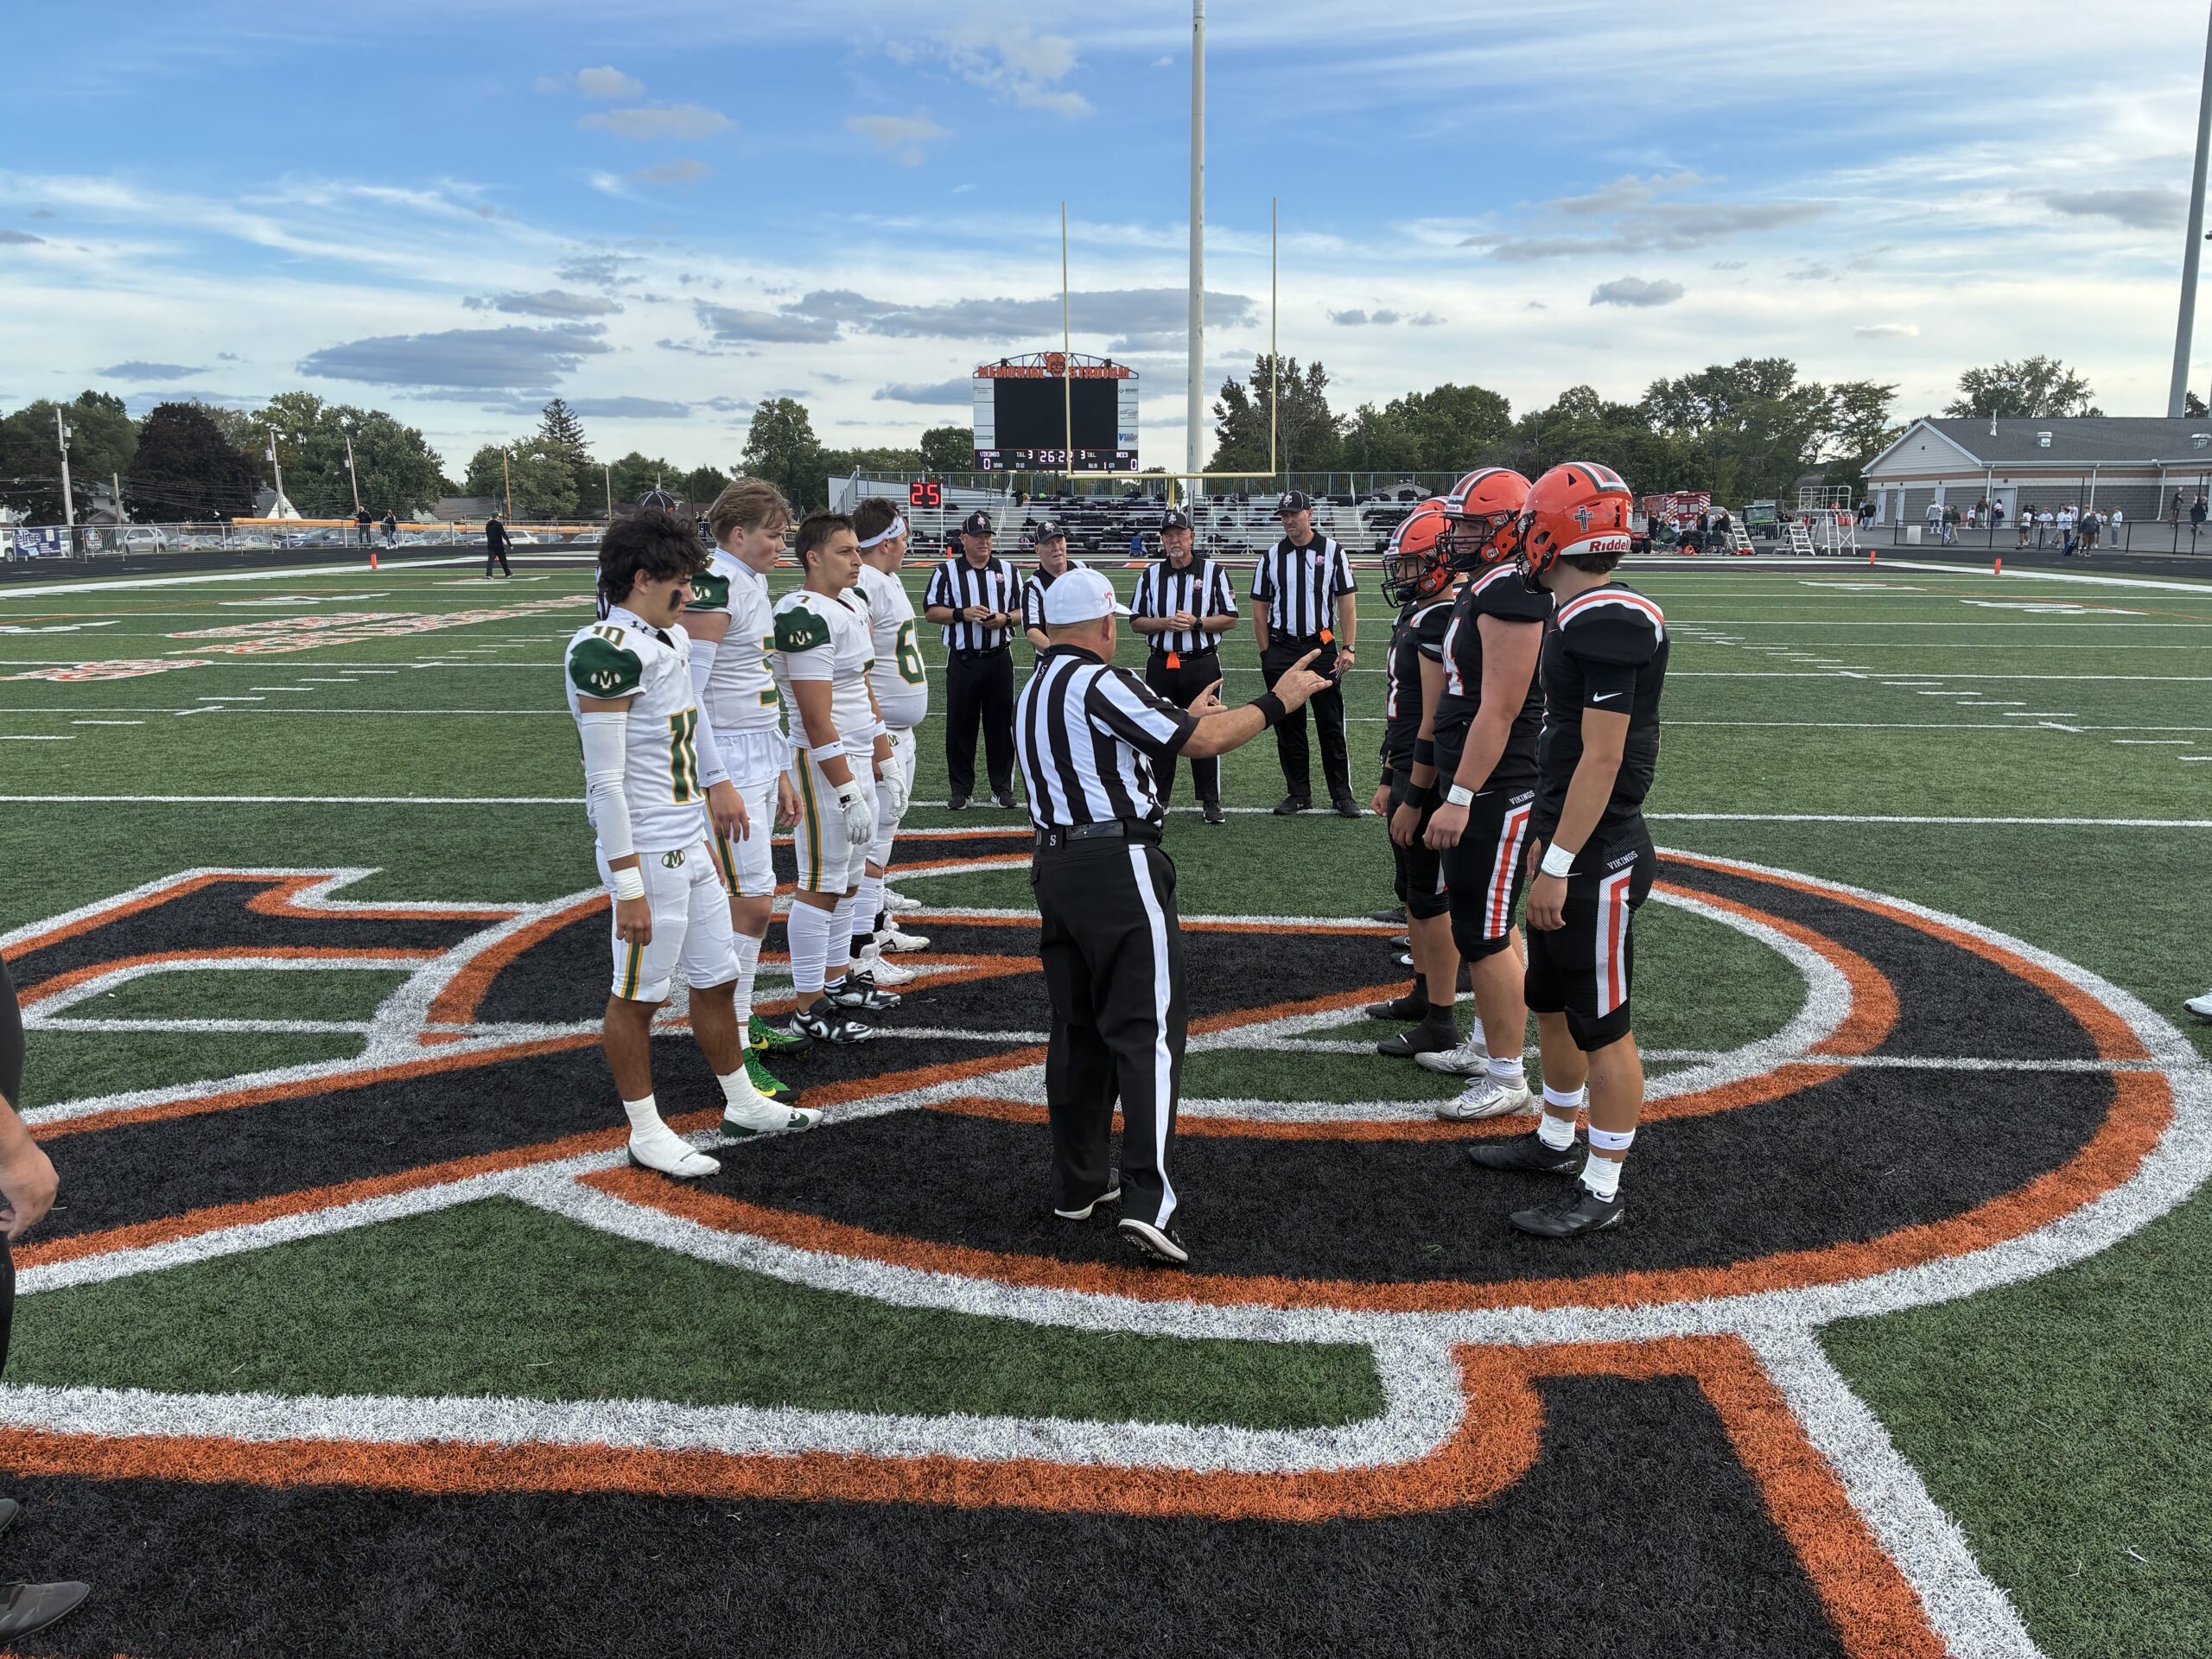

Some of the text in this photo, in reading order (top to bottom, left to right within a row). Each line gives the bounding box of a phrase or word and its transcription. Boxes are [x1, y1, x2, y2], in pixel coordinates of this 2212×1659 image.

[978, 365, 1129, 379] MEMORIAL STADIUM
[1027, 449, 1033, 460] 3
[1039, 450, 1074, 463] 26:22
[1080, 450, 1086, 460] 3
[983, 458, 991, 470] 0
[1103, 461, 1107, 470] 1
[1130, 458, 1137, 470] 0
[911, 483, 940, 505] 25
[1589, 539, 1630, 552] Riddell
[796, 594, 811, 604] 7
[591, 626, 626, 648] 10
[594, 670, 618, 690] M
[1509, 790, 1535, 805] VIKINGS
[1050, 835, 1057, 847] S
[1606, 850, 1638, 871] VIKINGS
